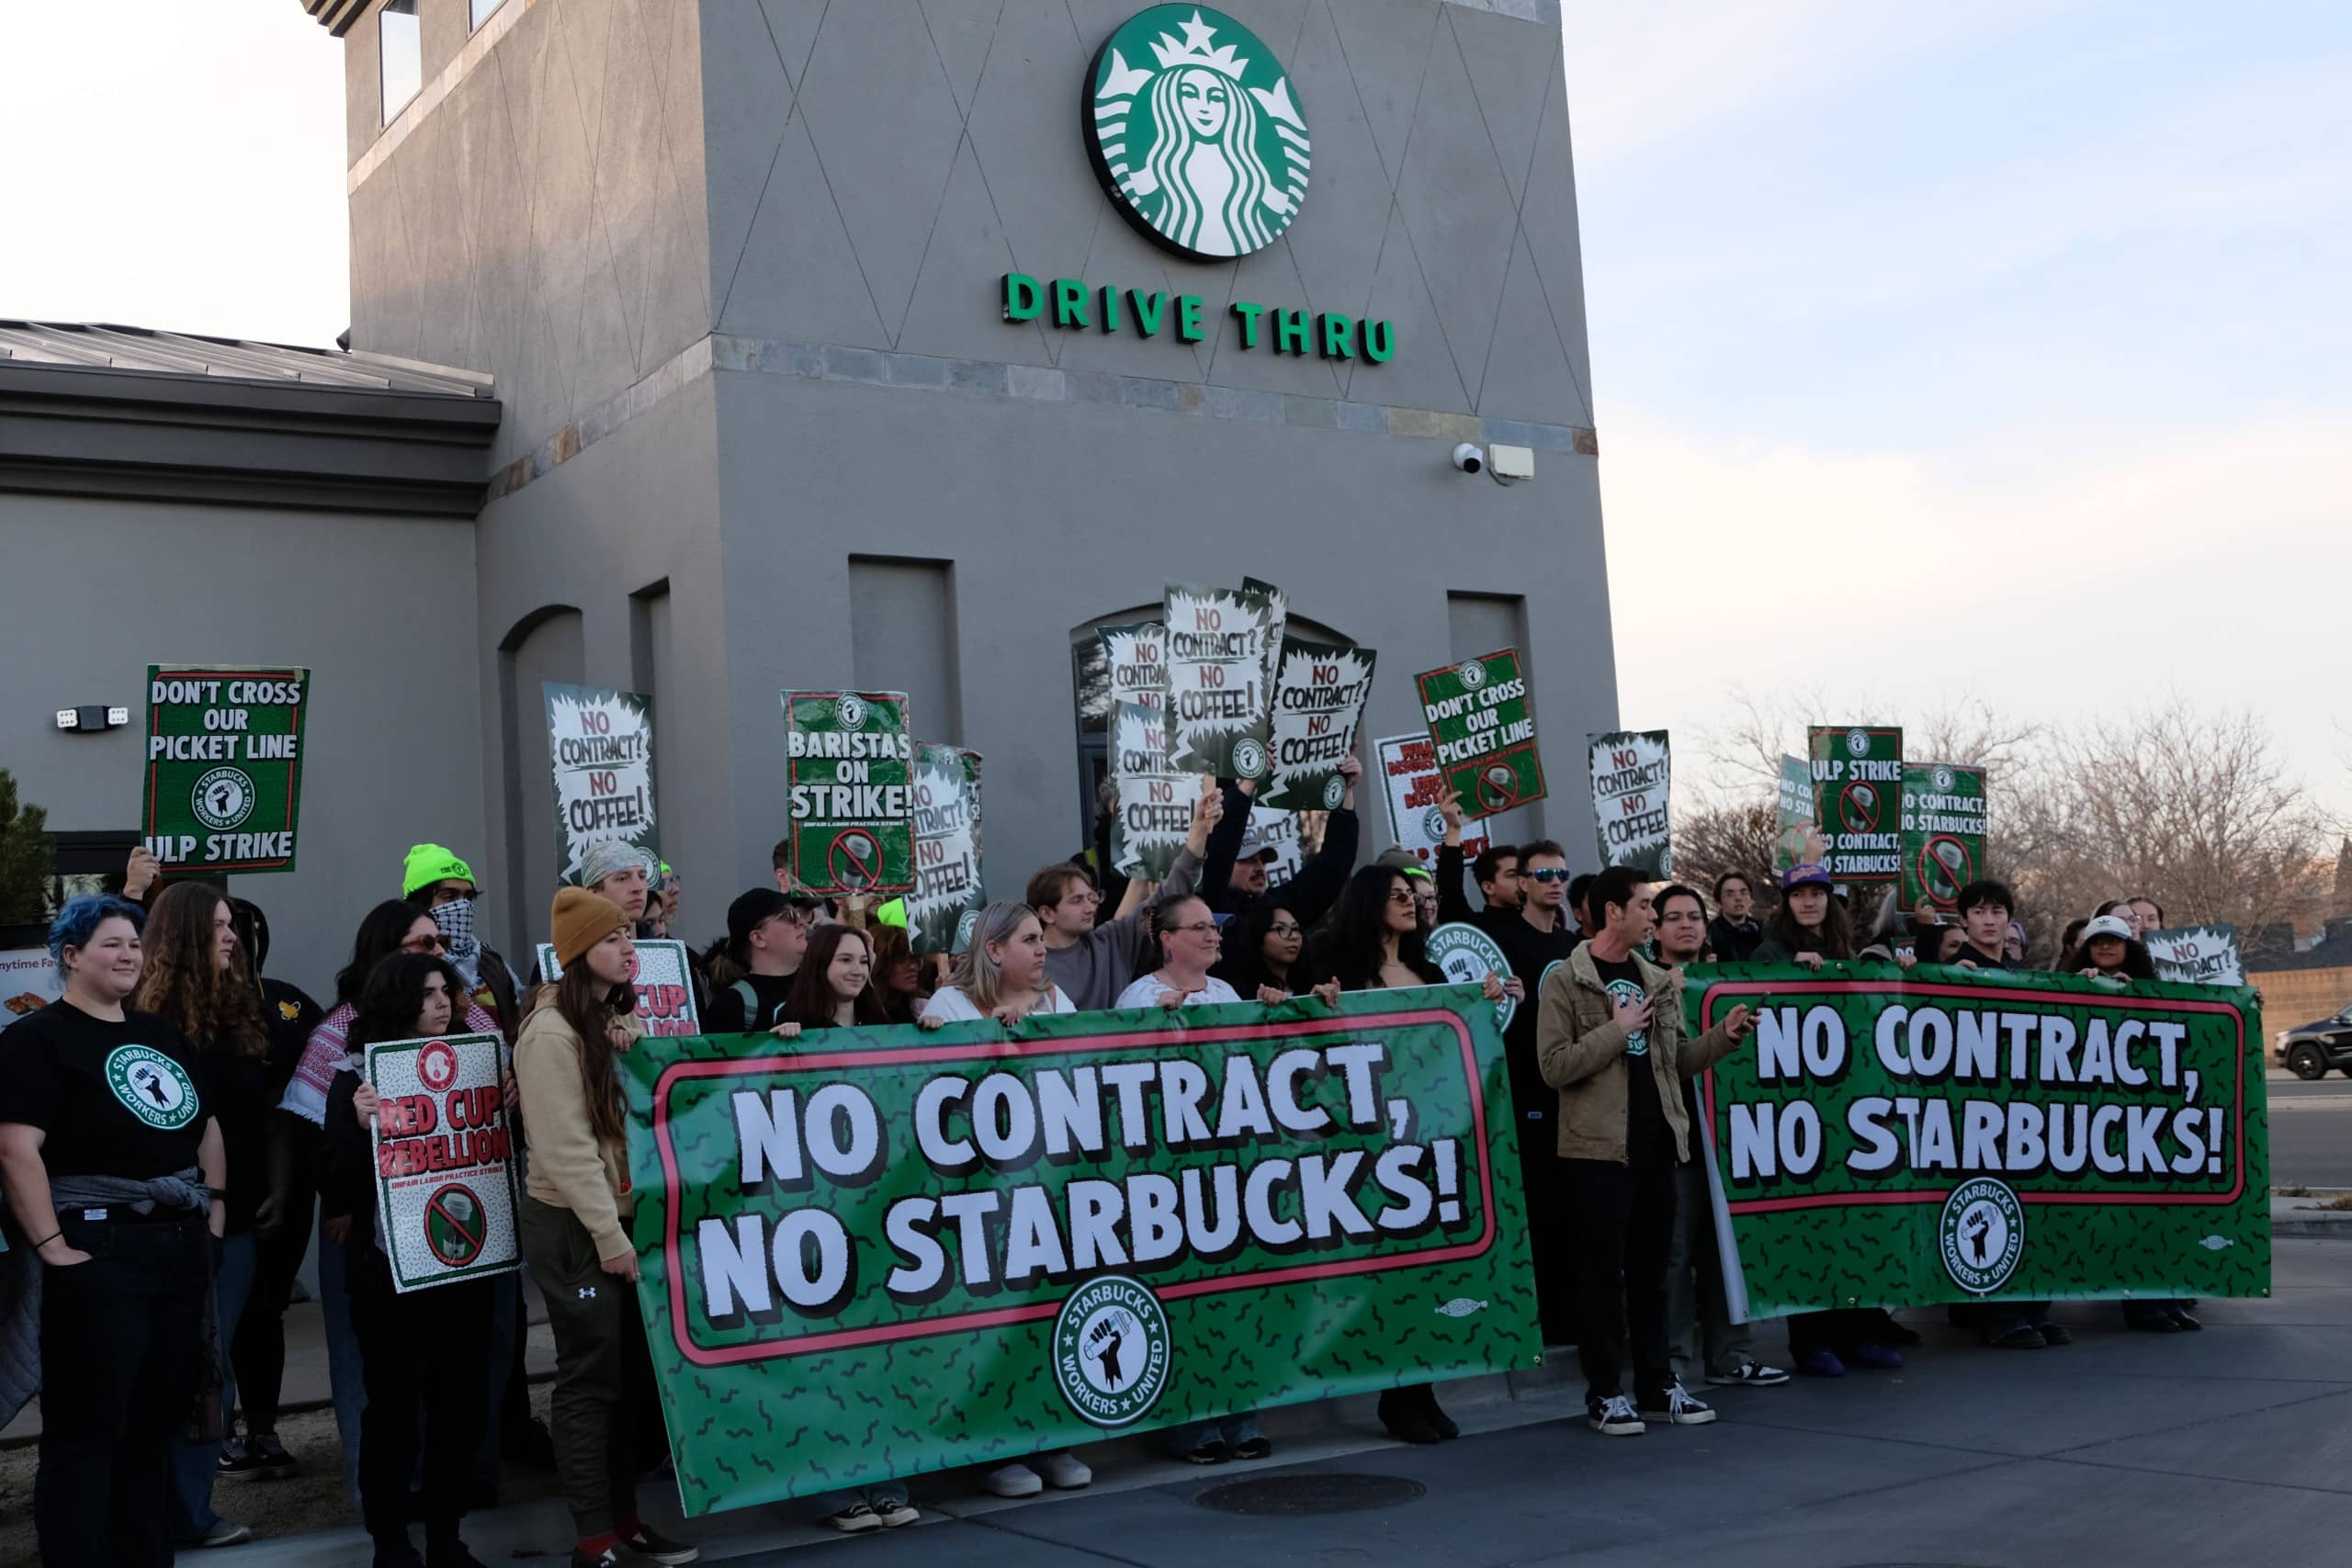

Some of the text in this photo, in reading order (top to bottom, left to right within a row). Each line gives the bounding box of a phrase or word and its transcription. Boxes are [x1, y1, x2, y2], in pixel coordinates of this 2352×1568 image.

[1001, 273, 1396, 365] DRIVE THRU
[1195, 608, 1221, 631] NO
[1135, 644, 1158, 662] NO
[1173, 628, 1256, 658] CONTRACT?
[1200, 666, 1224, 688] NO
[1312, 665, 1339, 685] NO
[152, 681, 301, 705] DON'T CROSS
[1181, 681, 1255, 722] COFFEE!
[1282, 682, 1362, 709] CONTRACT?
[1425, 678, 1525, 723] DON'T CROSS
[204, 708, 248, 730] OUR
[580, 711, 610, 735] NO
[1307, 715, 1330, 736] NO
[1465, 708, 1499, 733] OUR
[150, 734, 297, 761] PICKET LINE
[560, 730, 642, 766] CONTRACT?
[788, 731, 911, 760] BARISTAS
[1281, 726, 1349, 765] COFFEE!
[1437, 732, 1497, 765] PICKET
[1501, 717, 1533, 747] LINE
[836, 760, 868, 784] ON
[1611, 749, 1637, 771] NO
[1812, 760, 1901, 781] ULP STRIKE
[201, 770, 248, 787] STARBUCKS
[589, 771, 617, 796] NO
[1149, 781, 1173, 803] NO
[1597, 759, 1666, 796] CONTRACT?
[1781, 778, 1794, 795] NO
[196, 795, 251, 827] WORKERS UNITED
[570, 785, 645, 833] COFFEE!
[791, 784, 913, 818] STRIKE!
[1127, 798, 1194, 832] COFFEE!
[1621, 793, 1646, 816] NO
[1780, 795, 1792, 811] NO
[1918, 794, 1986, 818] CONTRACT,
[1608, 800, 1668, 844] COFFEE!
[1917, 814, 1986, 835] STARBUCKS!
[145, 831, 293, 863] ULP STRIKE
[919, 840, 944, 867] NO
[1838, 833, 1901, 853] CONTRACT,
[908, 852, 972, 903] OFFEE!
[1835, 854, 1901, 873] STARBUCKS!
[1433, 931, 1503, 971] STARBUCKS
[2170, 942, 2199, 962] NO
[634, 984, 687, 1020] CUP
[113, 1049, 173, 1072] STARBUCKS
[1757, 1004, 2199, 1102] NO CONTRACT,
[118, 1081, 196, 1125] WORKERS UNITED
[379, 1085, 502, 1140] RED CUP
[733, 1043, 1408, 1184] NO CONTRACT,
[1729, 1097, 2224, 1179] NO STARBUCKS!
[378, 1127, 511, 1179] REBELLION
[445, 1170, 478, 1181] PRACTICE
[1951, 1183, 2015, 1214] STARBUCKS
[698, 1138, 1461, 1318] NO STARBUCKS!
[1945, 1232, 2018, 1285] WORKERS UNITED
[1068, 1284, 1153, 1328] STARBUCKS
[1062, 1339, 1163, 1415] WORKERS UNITED
